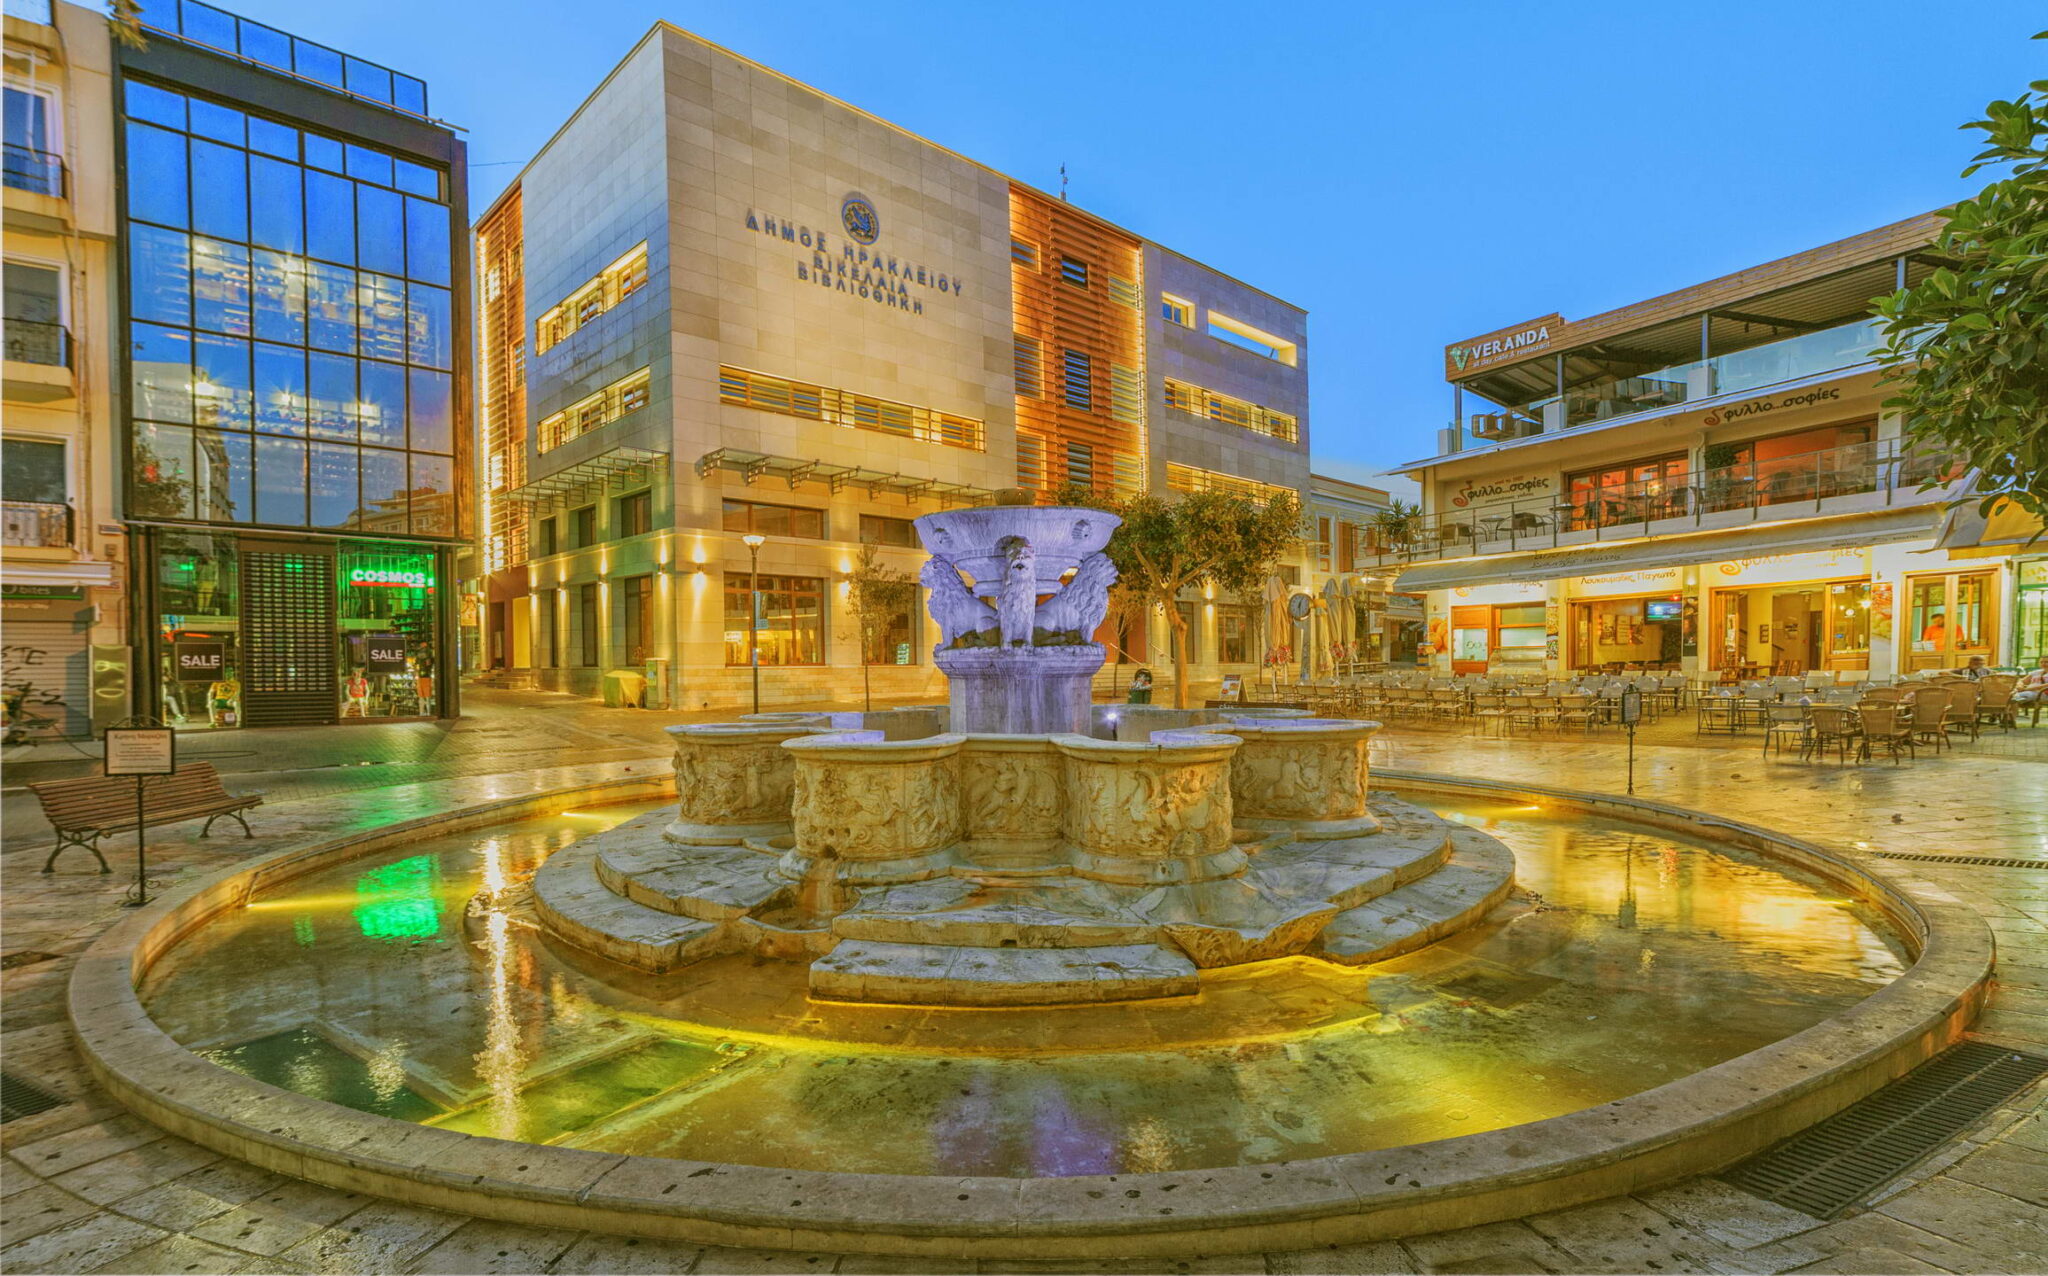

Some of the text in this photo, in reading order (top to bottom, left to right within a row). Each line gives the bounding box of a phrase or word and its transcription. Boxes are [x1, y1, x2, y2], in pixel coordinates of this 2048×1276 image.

[746, 212, 962, 297] ΔΗΜΟΣ ΗΡΑΚΛΕΙΟΥ
[798, 266, 923, 315] ΒΙΒΛΙΟΘΗΚΗ
[813, 255, 908, 297] ΒΙΚΕΛΑΙΑ
[1472, 327, 1549, 359] VERANDA
[351, 569, 425, 584] COSMOS
[180, 654, 221, 667] SALE
[370, 649, 404, 660] SALE
